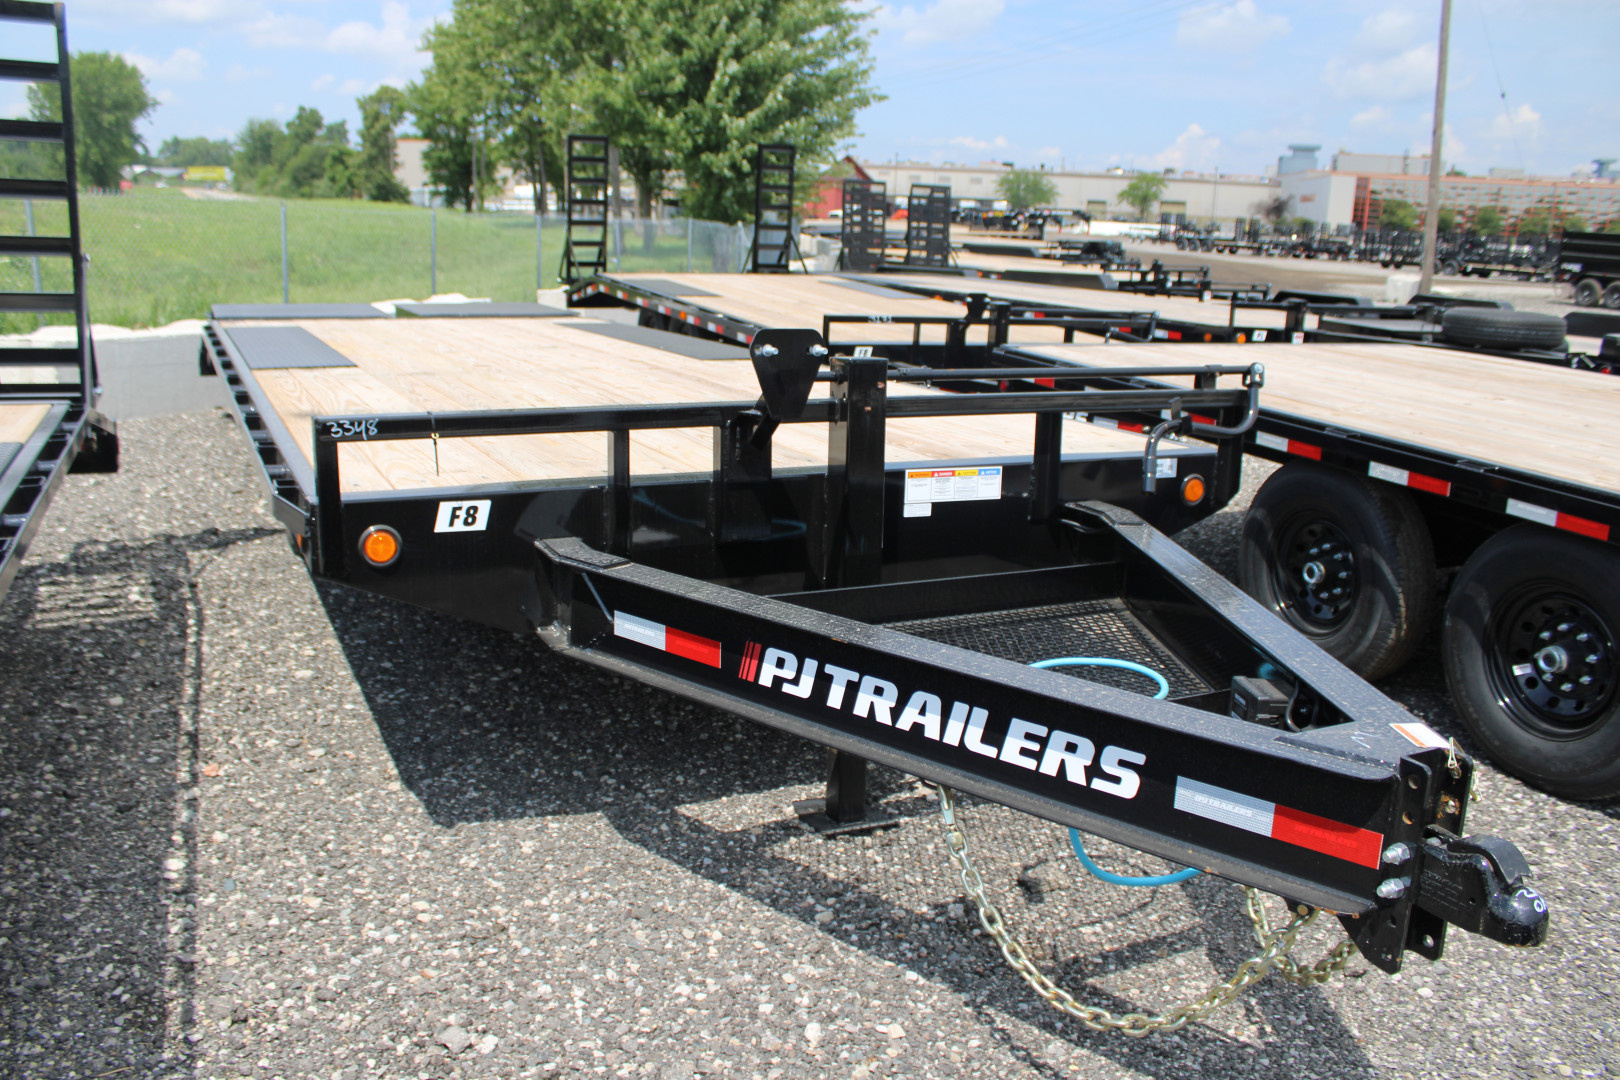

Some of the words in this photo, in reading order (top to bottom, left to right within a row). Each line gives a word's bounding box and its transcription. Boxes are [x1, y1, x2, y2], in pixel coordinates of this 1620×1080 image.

[326, 418, 379, 440] 3348
[448, 505, 479, 527] F8
[758, 647, 818, 699] PJ
[824, 662, 1147, 800] TRAILERS
